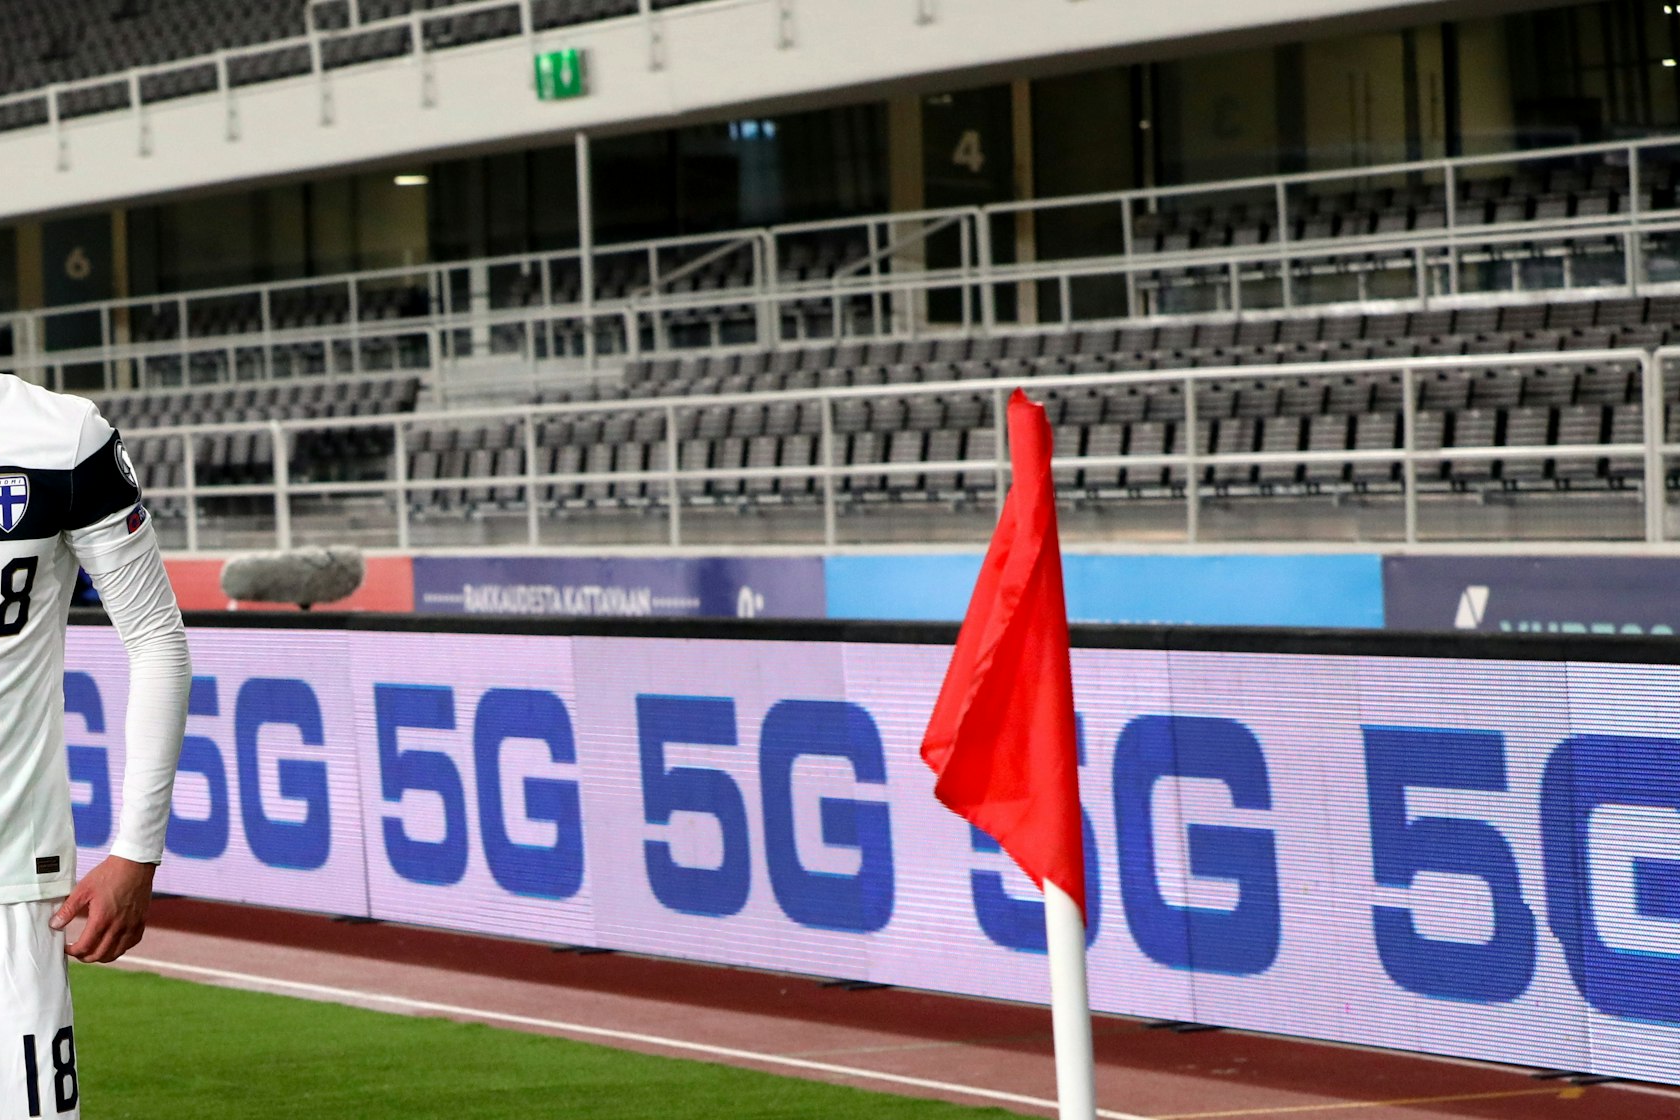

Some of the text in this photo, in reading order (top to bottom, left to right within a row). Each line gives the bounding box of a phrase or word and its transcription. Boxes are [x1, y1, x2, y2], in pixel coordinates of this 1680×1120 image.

[953, 129, 984, 173] 4
[65, 246, 90, 279] 6
[373, 682, 585, 901] 5G
[635, 693, 897, 935] 5G
[23, 1025, 79, 1117] 18
